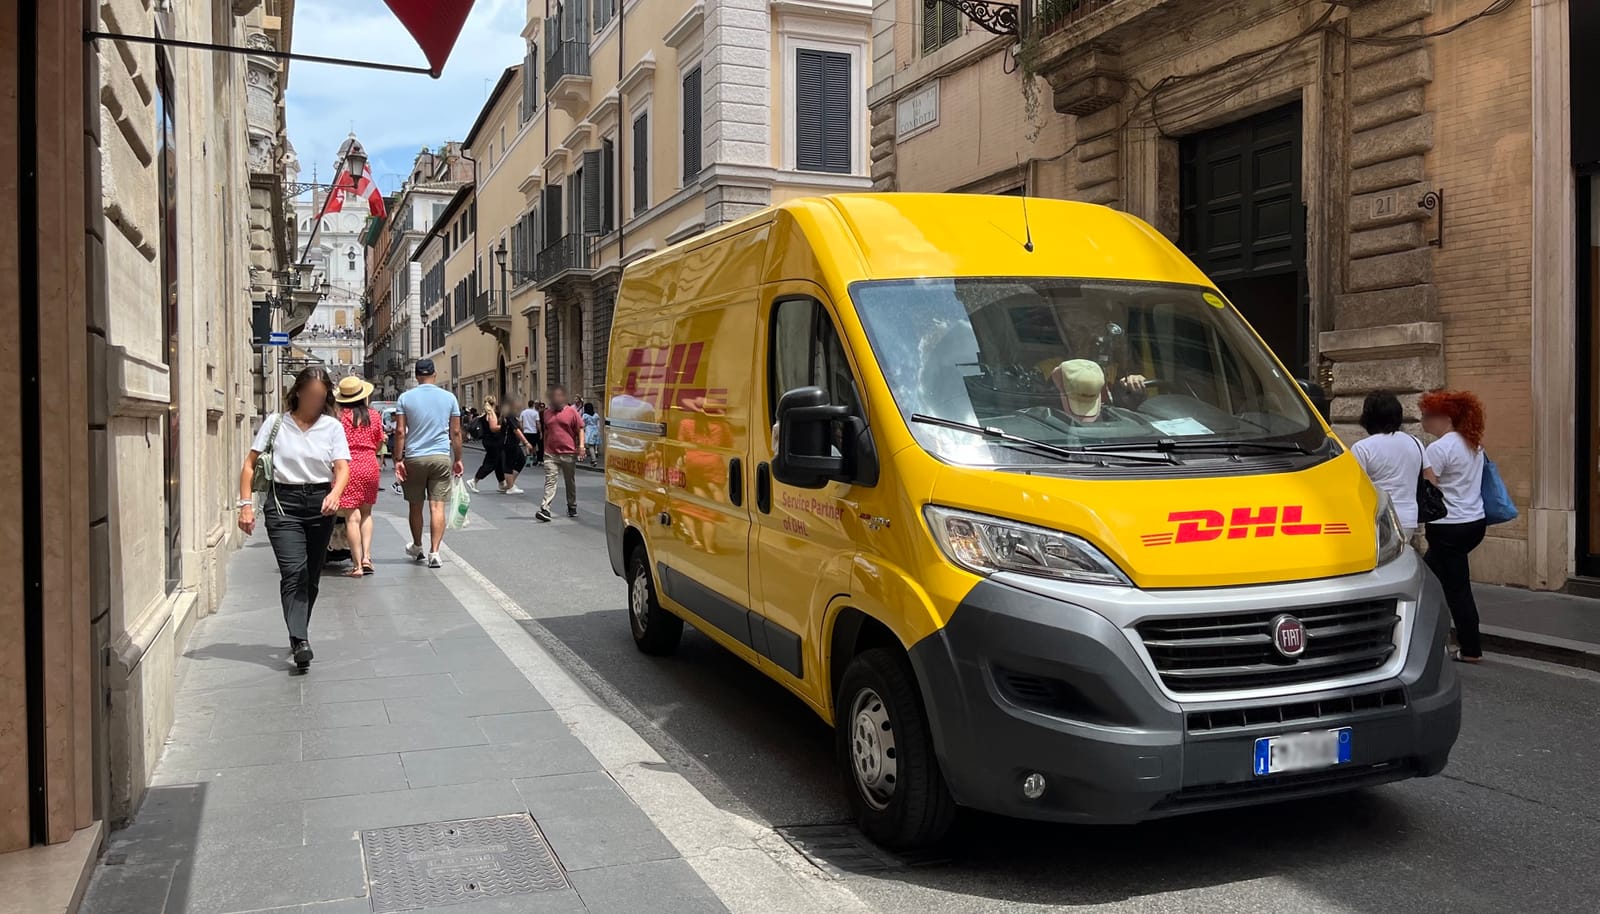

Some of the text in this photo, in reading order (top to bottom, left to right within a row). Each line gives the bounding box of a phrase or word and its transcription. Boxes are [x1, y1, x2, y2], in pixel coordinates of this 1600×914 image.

[900, 109, 935, 133] CONDOTTI
[1376, 196, 1391, 214] 21
[782, 491, 844, 521] Service Partner
[783, 517, 809, 536] of DHL
[1168, 505, 1322, 544] DHL
[1281, 628, 1300, 648] FIAT
